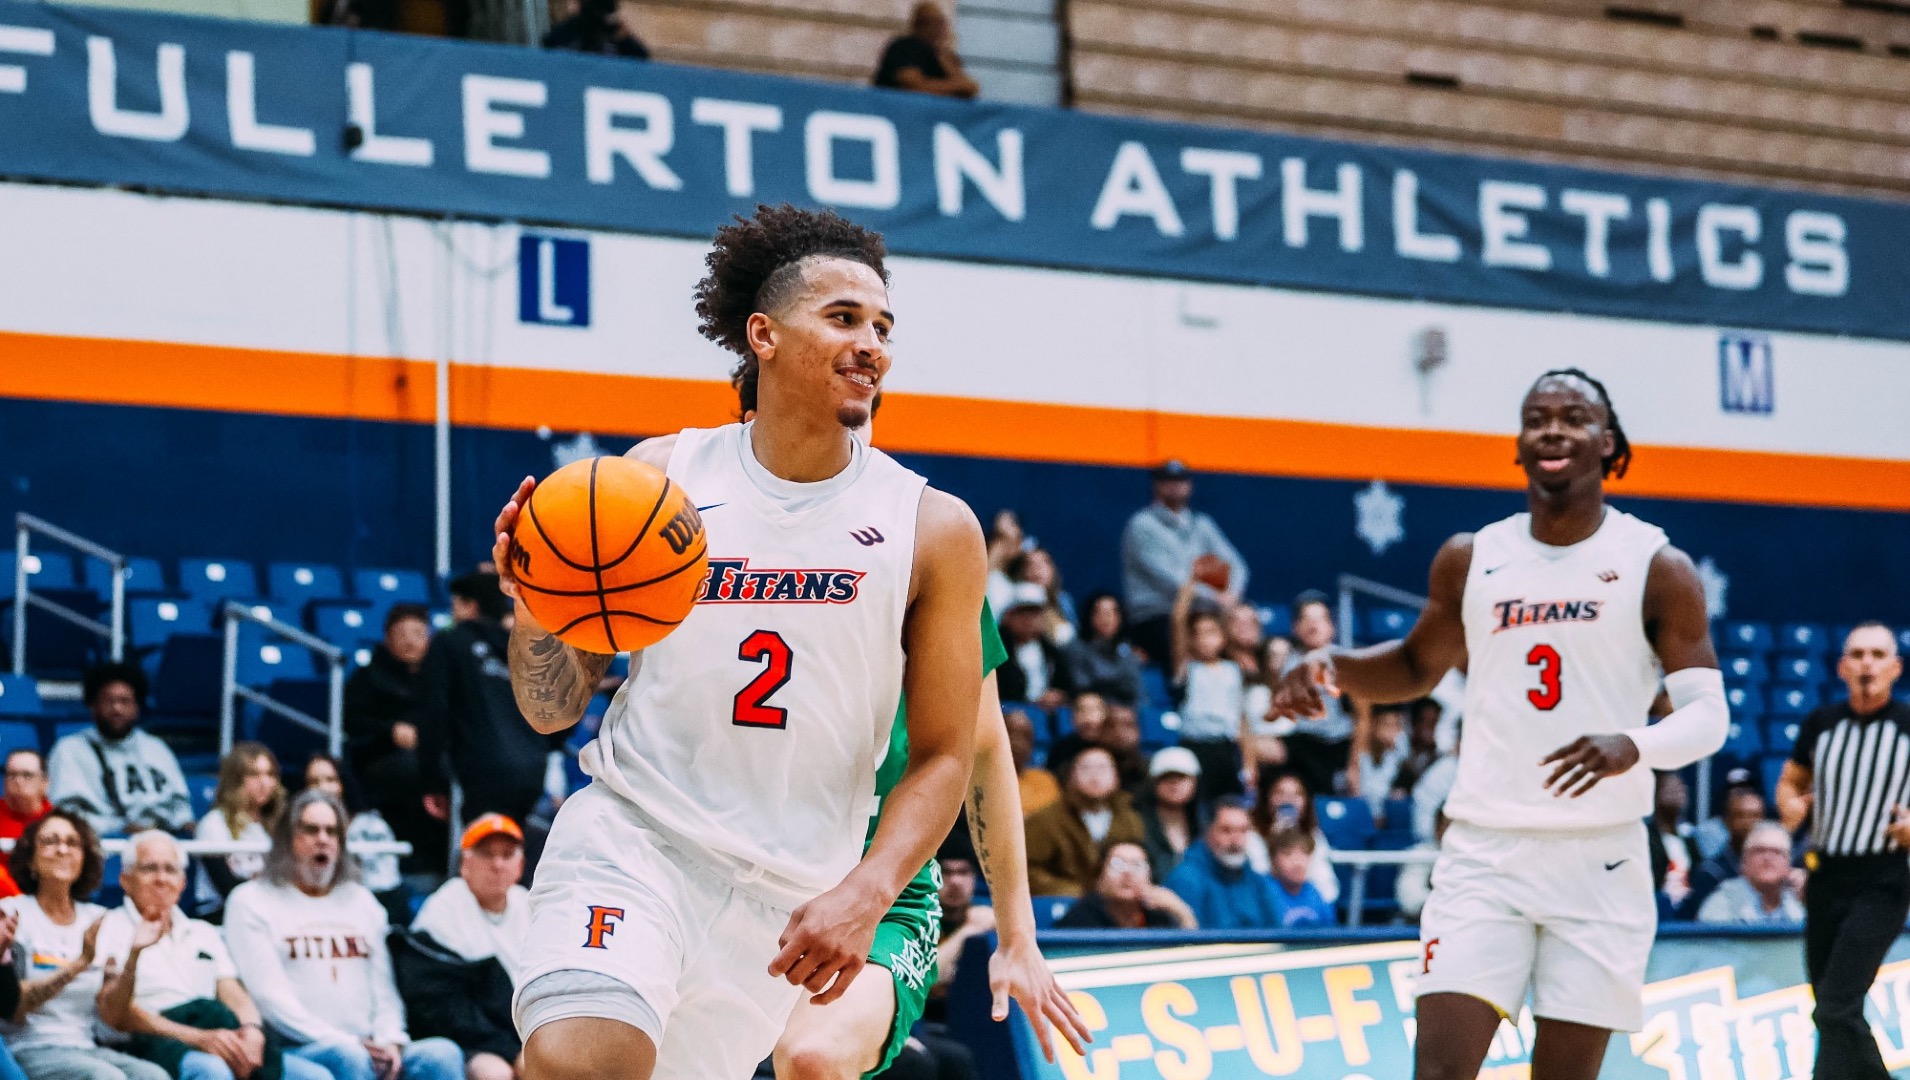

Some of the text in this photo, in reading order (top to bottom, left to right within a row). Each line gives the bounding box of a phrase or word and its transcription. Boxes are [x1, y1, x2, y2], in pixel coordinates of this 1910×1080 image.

[1090, 141, 1850, 298] ATHLETICS
[539, 240, 574, 320] L
[1727, 341, 1765, 409] M
[700, 560, 862, 603] TITANS
[1493, 597, 1604, 632] TITANS
[732, 629, 794, 730] 2
[1526, 643, 1562, 711] 3
[108, 763, 168, 795] AP
[581, 905, 625, 949] F
[1045, 963, 1382, 1080] C-S-U-F
